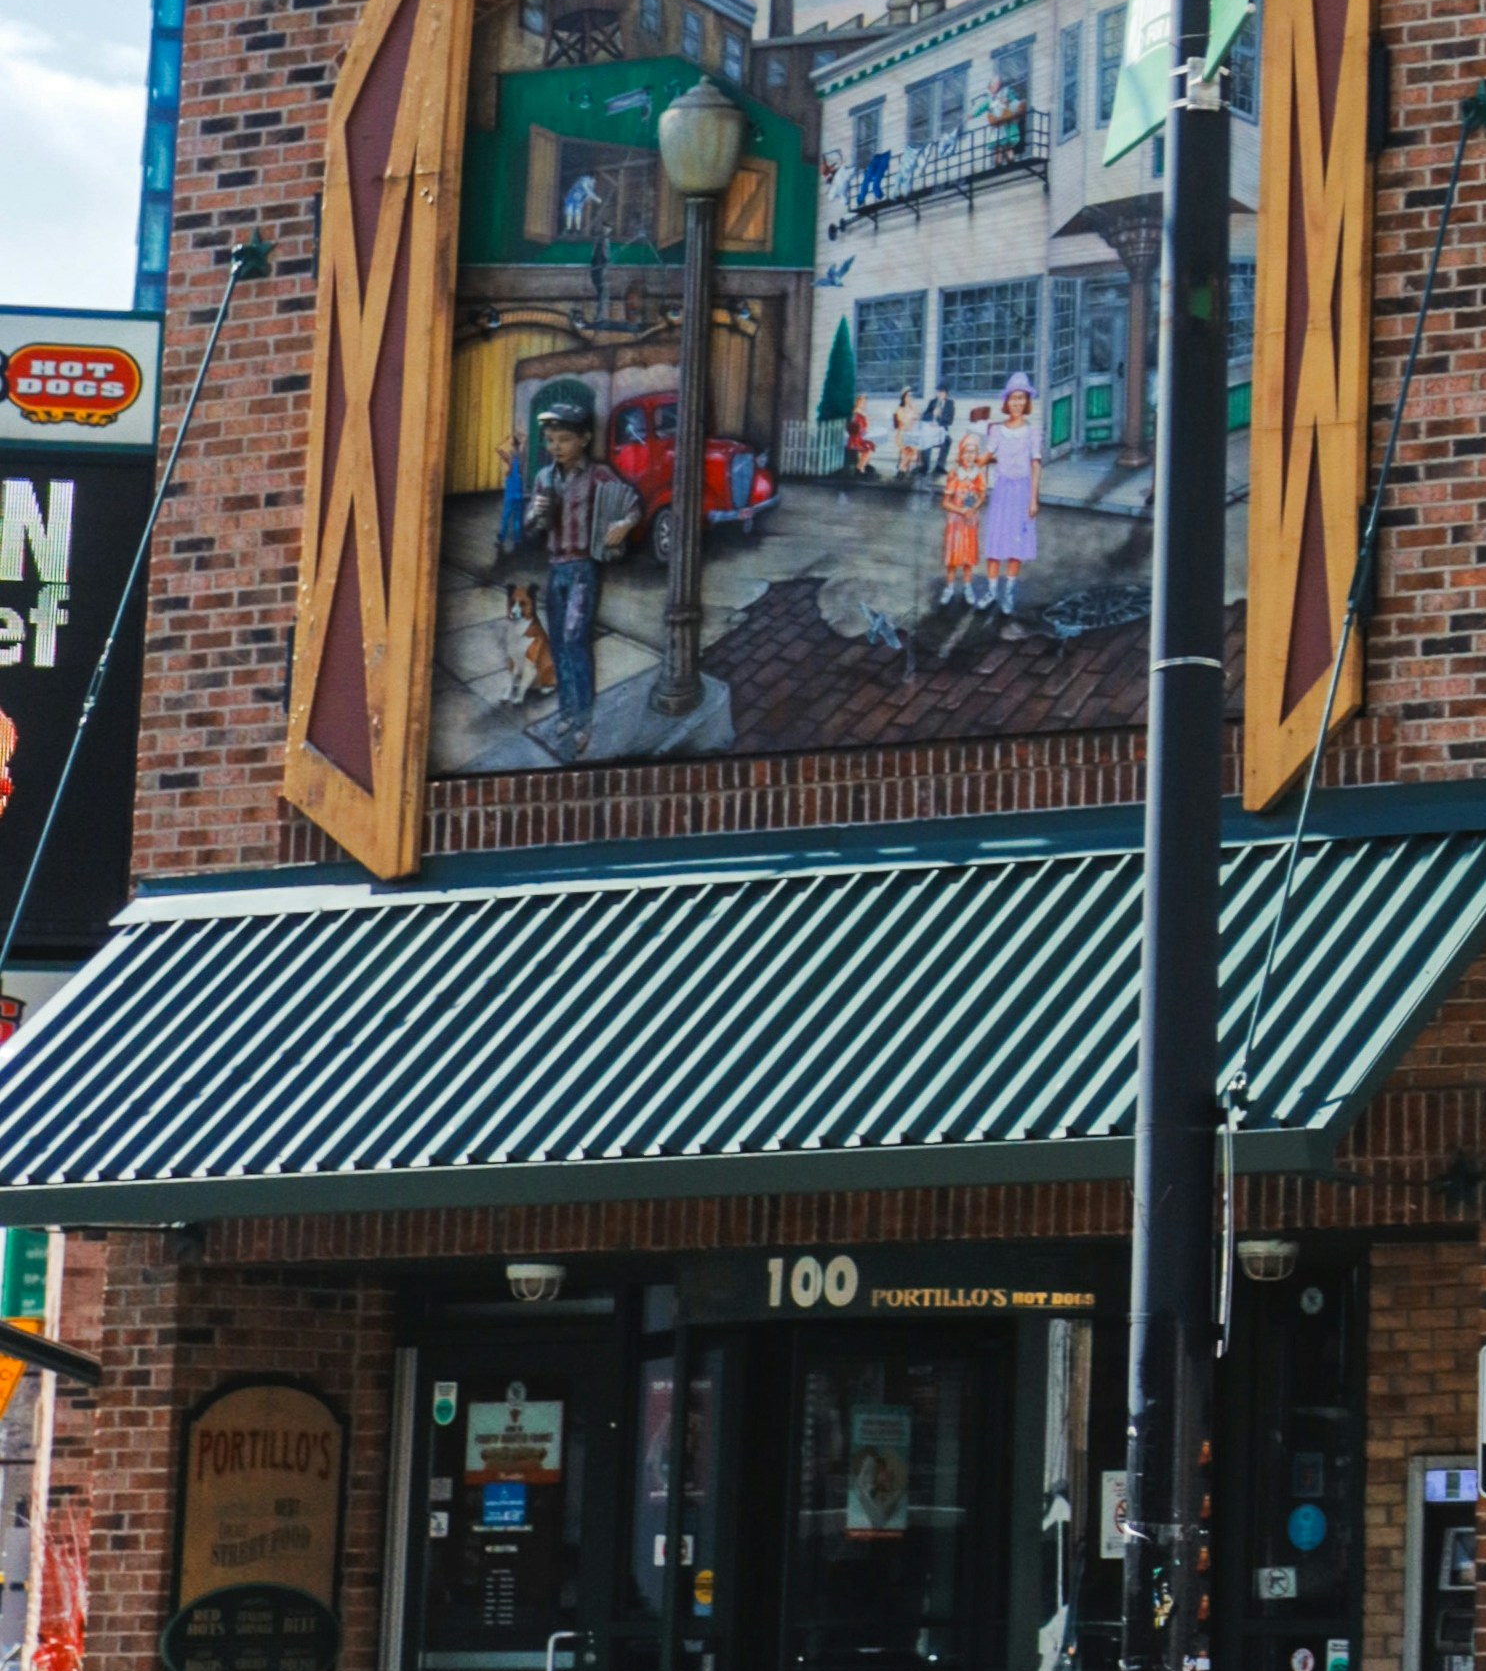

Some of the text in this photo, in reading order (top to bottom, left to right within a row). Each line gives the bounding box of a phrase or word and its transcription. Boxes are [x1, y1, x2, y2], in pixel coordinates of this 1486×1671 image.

[30, 359, 115, 380] HOT
[16, 377, 126, 399] DOGS
[768, 1255, 859, 1308] 100
[871, 1289, 1096, 1308] PORTILLO'S HOT DOGS
[195, 1428, 333, 1482] PORTILLO'S
